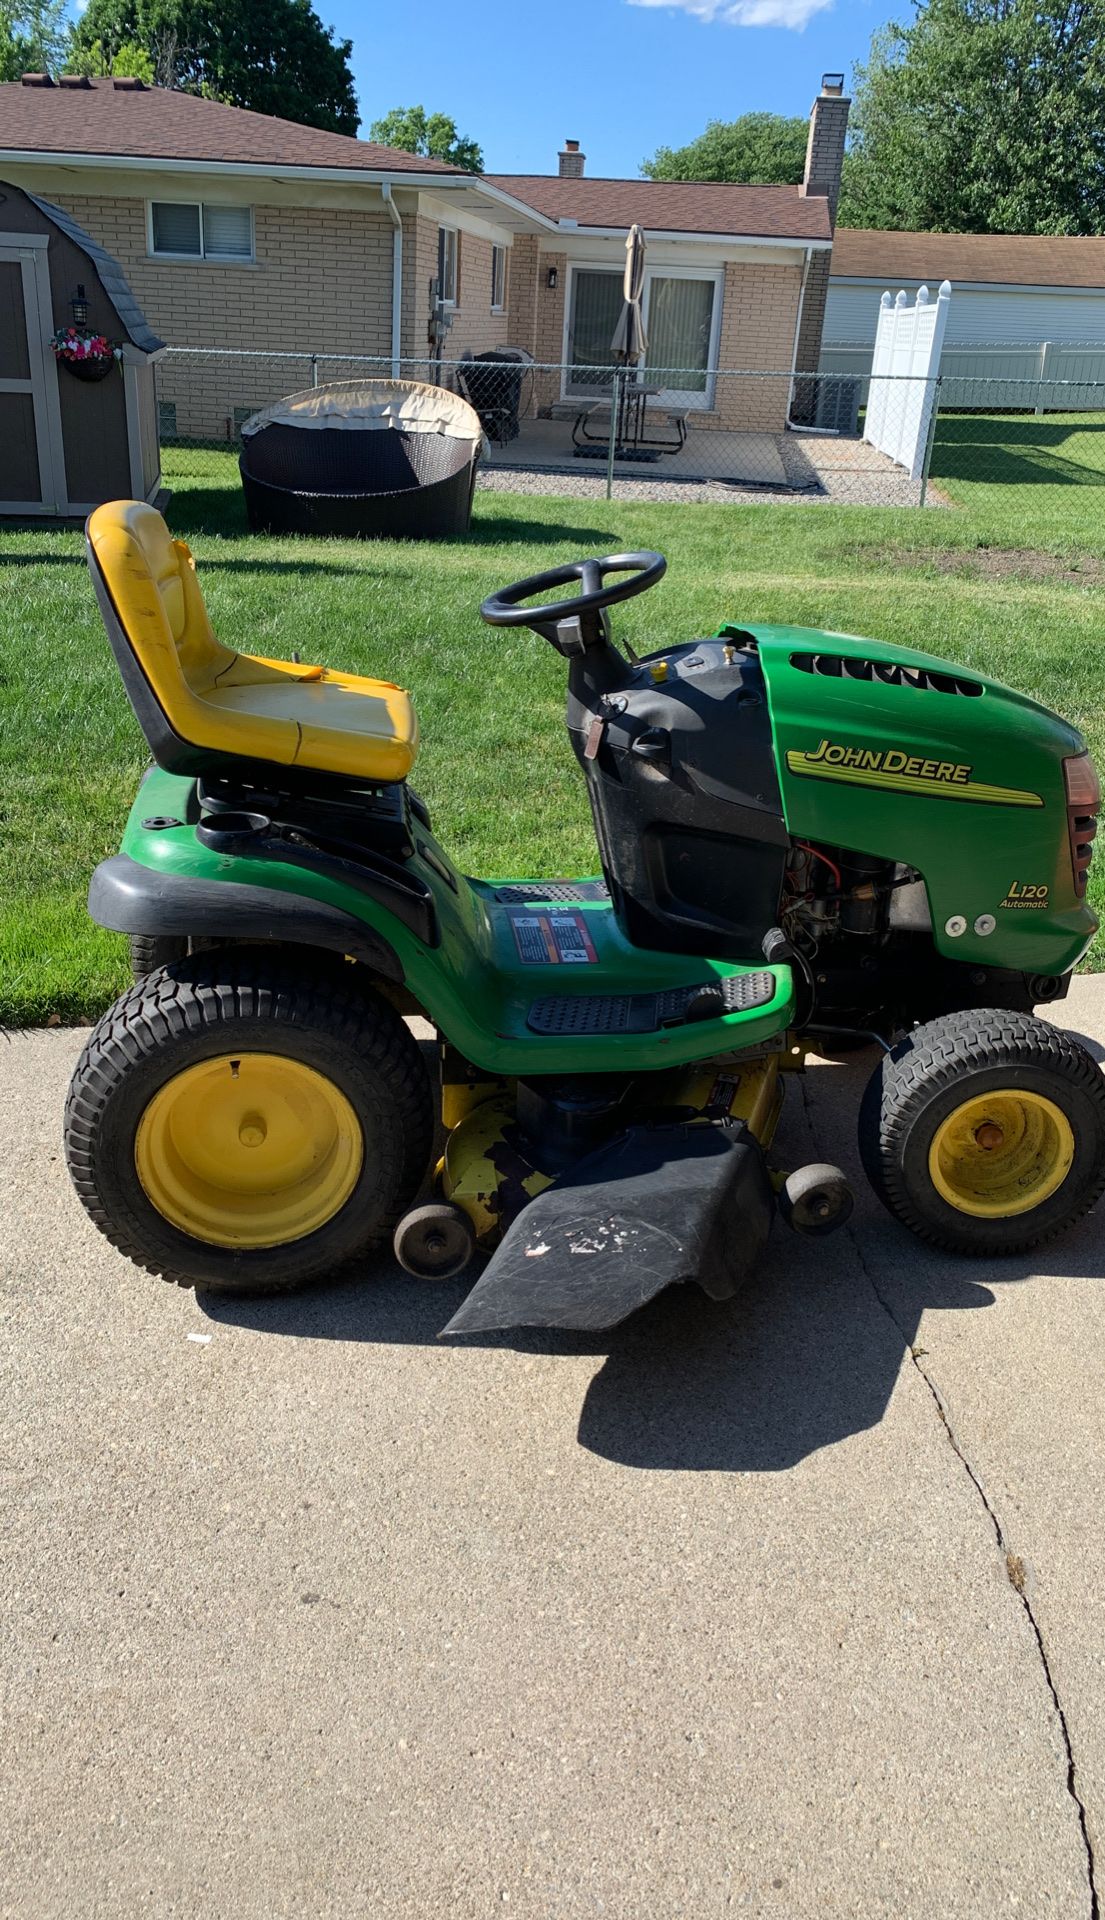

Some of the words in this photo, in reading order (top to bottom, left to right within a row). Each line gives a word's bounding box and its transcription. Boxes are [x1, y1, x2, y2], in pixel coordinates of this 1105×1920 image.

[805, 739, 882, 770] JOHN
[882, 750, 971, 783] DEERE
[1007, 880, 1048, 898] L120
[999, 898, 1049, 909] Automatic
